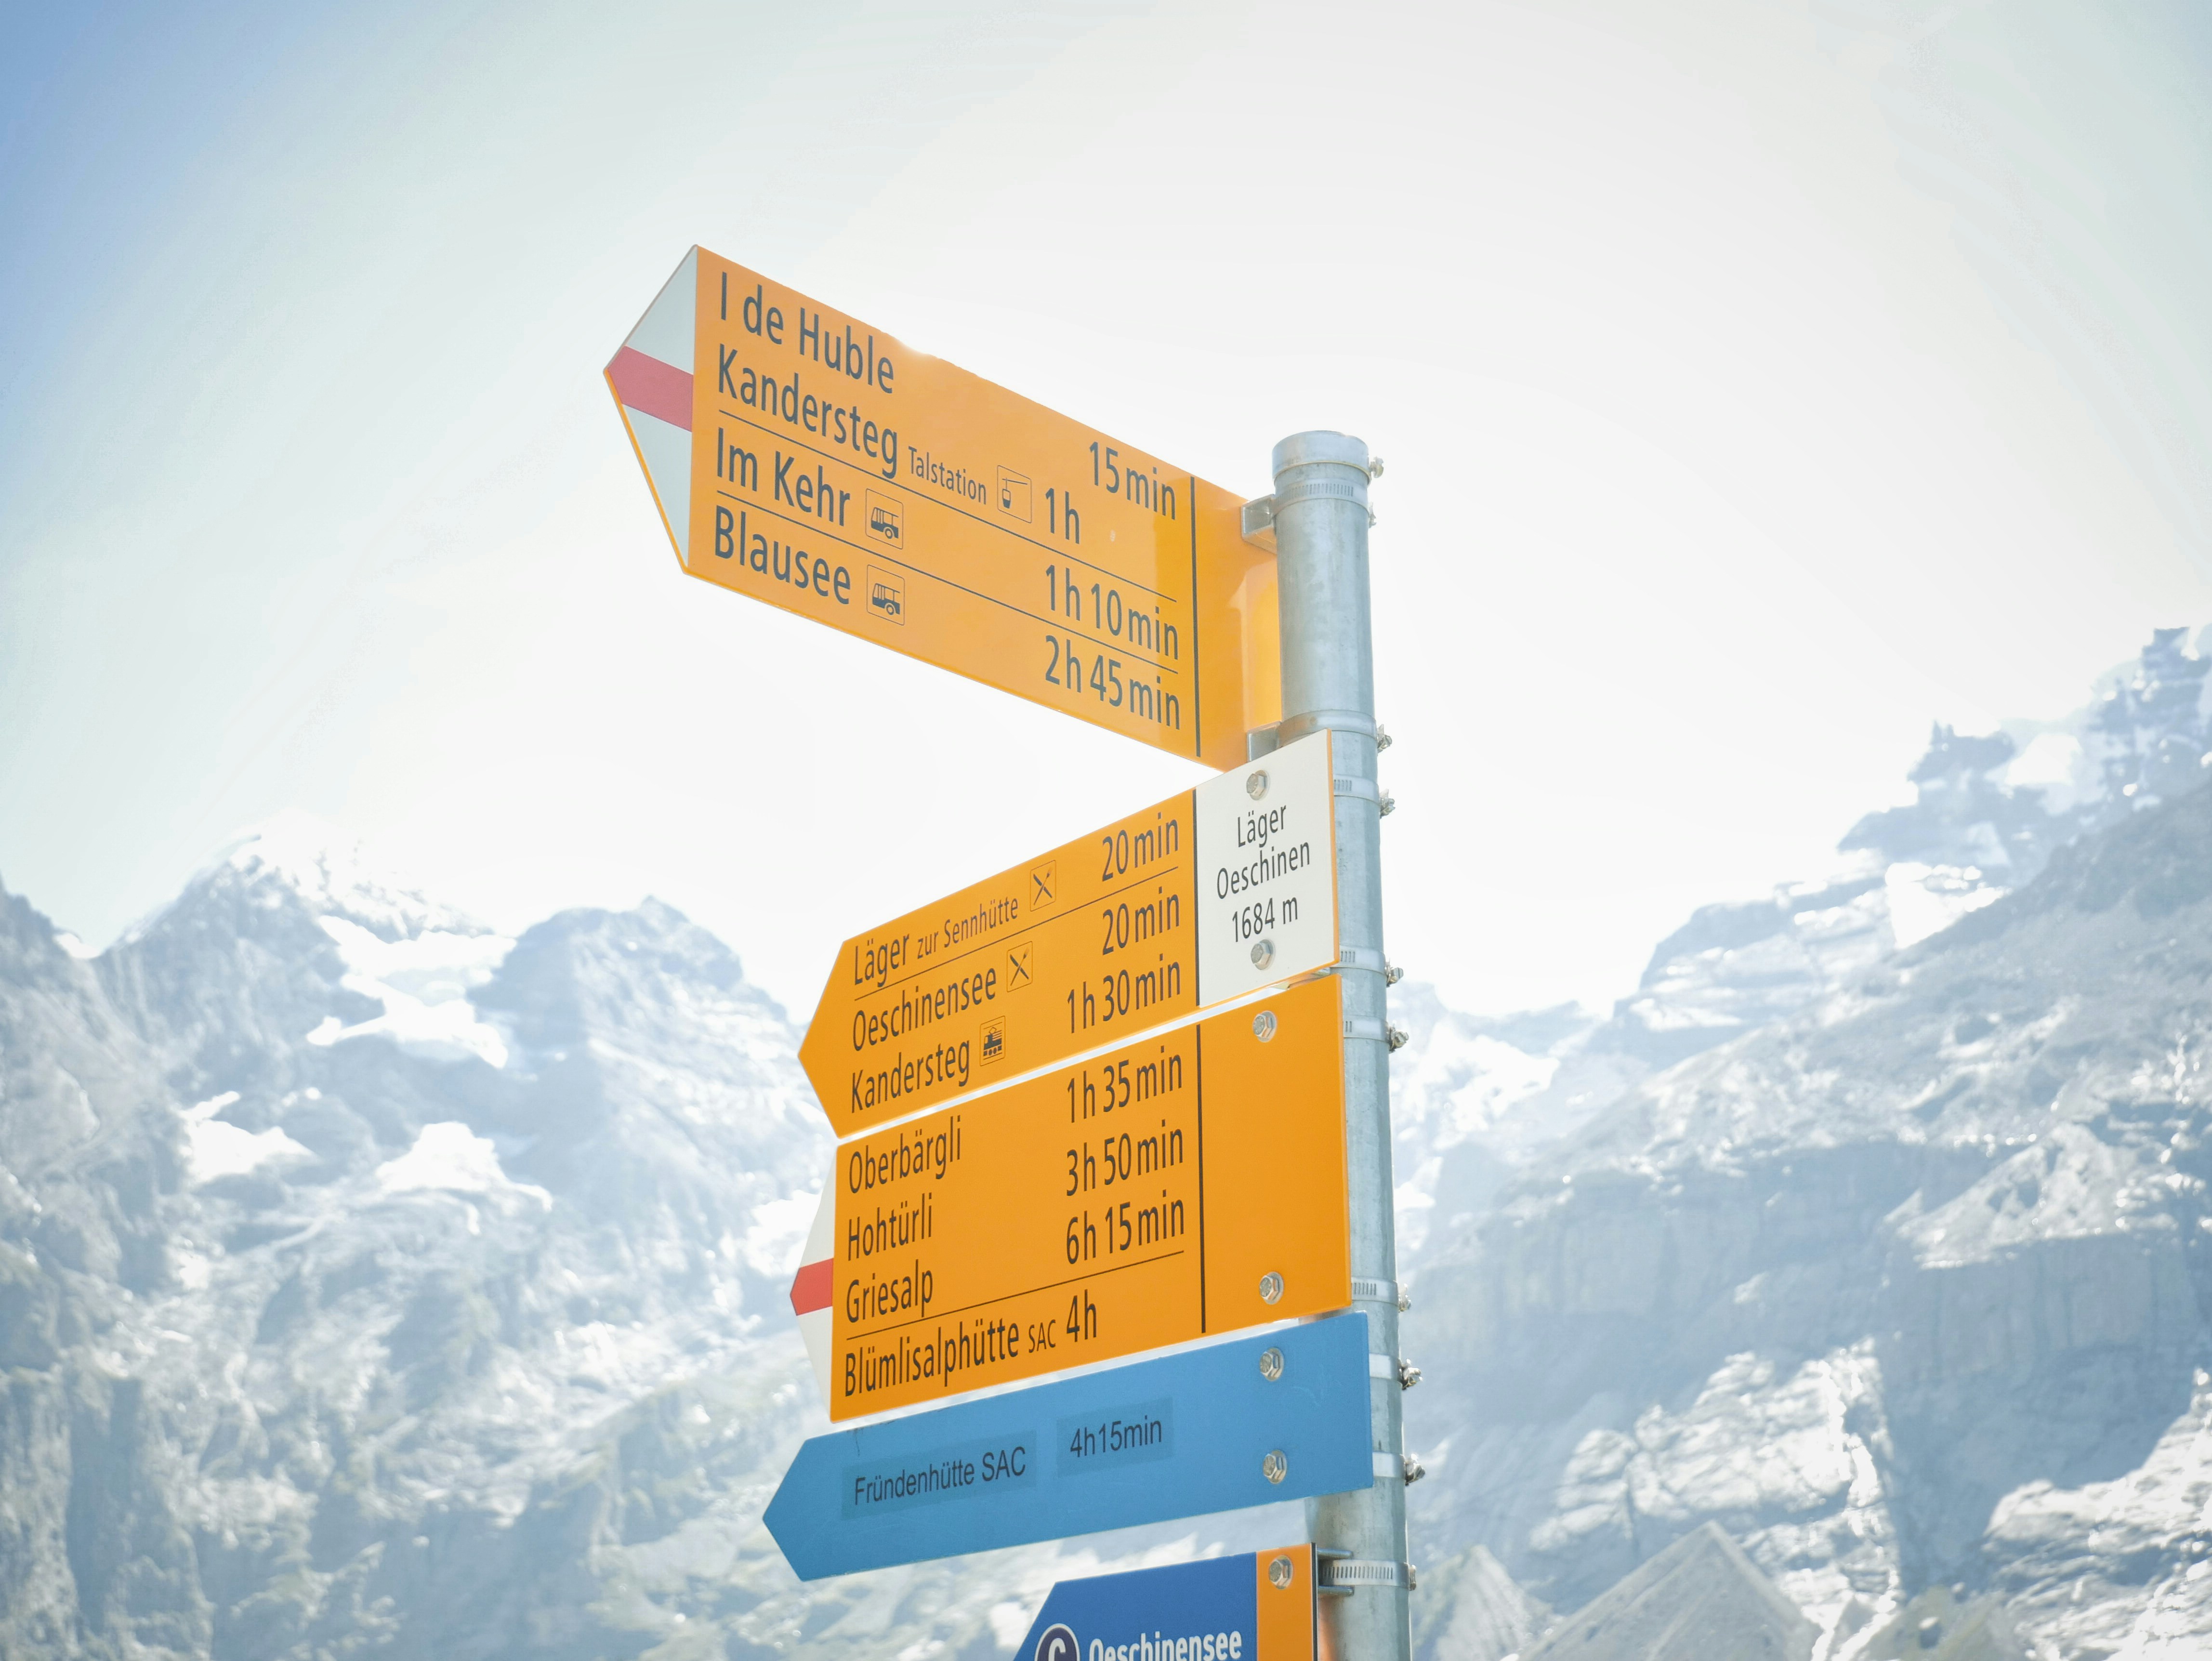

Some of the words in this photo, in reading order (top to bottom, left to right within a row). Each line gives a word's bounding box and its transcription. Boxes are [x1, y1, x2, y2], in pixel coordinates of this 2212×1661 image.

[743, 284, 784, 345] de
[800, 307, 894, 394] Huble
[719, 343, 897, 478] Kandersteg
[908, 446, 987, 505] Talstation
[717, 427, 757, 492] Im
[775, 450, 850, 527] Kehr
[715, 505, 851, 605] Blausee
[1237, 804, 1286, 849] Läger
[1217, 842, 1310, 900] Oeschinen
[855, 933, 909, 988] Läger
[917, 931, 939, 960] zur
[944, 897, 1018, 949] Sennhütte
[1232, 897, 1275, 943] 1684
[1283, 896, 1298, 924] m
[853, 967, 996, 1052] Oeschinensee
[852, 1039, 970, 1114] Kandersteg
[849, 1115, 961, 1194] Oberbärgli
[848, 1192, 933, 1261] Hohtürli
[846, 1259, 934, 1323] Griesalp
[845, 1318, 1019, 1397] Blümlisalphütte
[1028, 1319, 1056, 1354] SAC
[1066, 1289, 1097, 1343] 4h
[855, 1459, 975, 1506] Fründenhütte
[981, 1446, 1026, 1482] SAC
